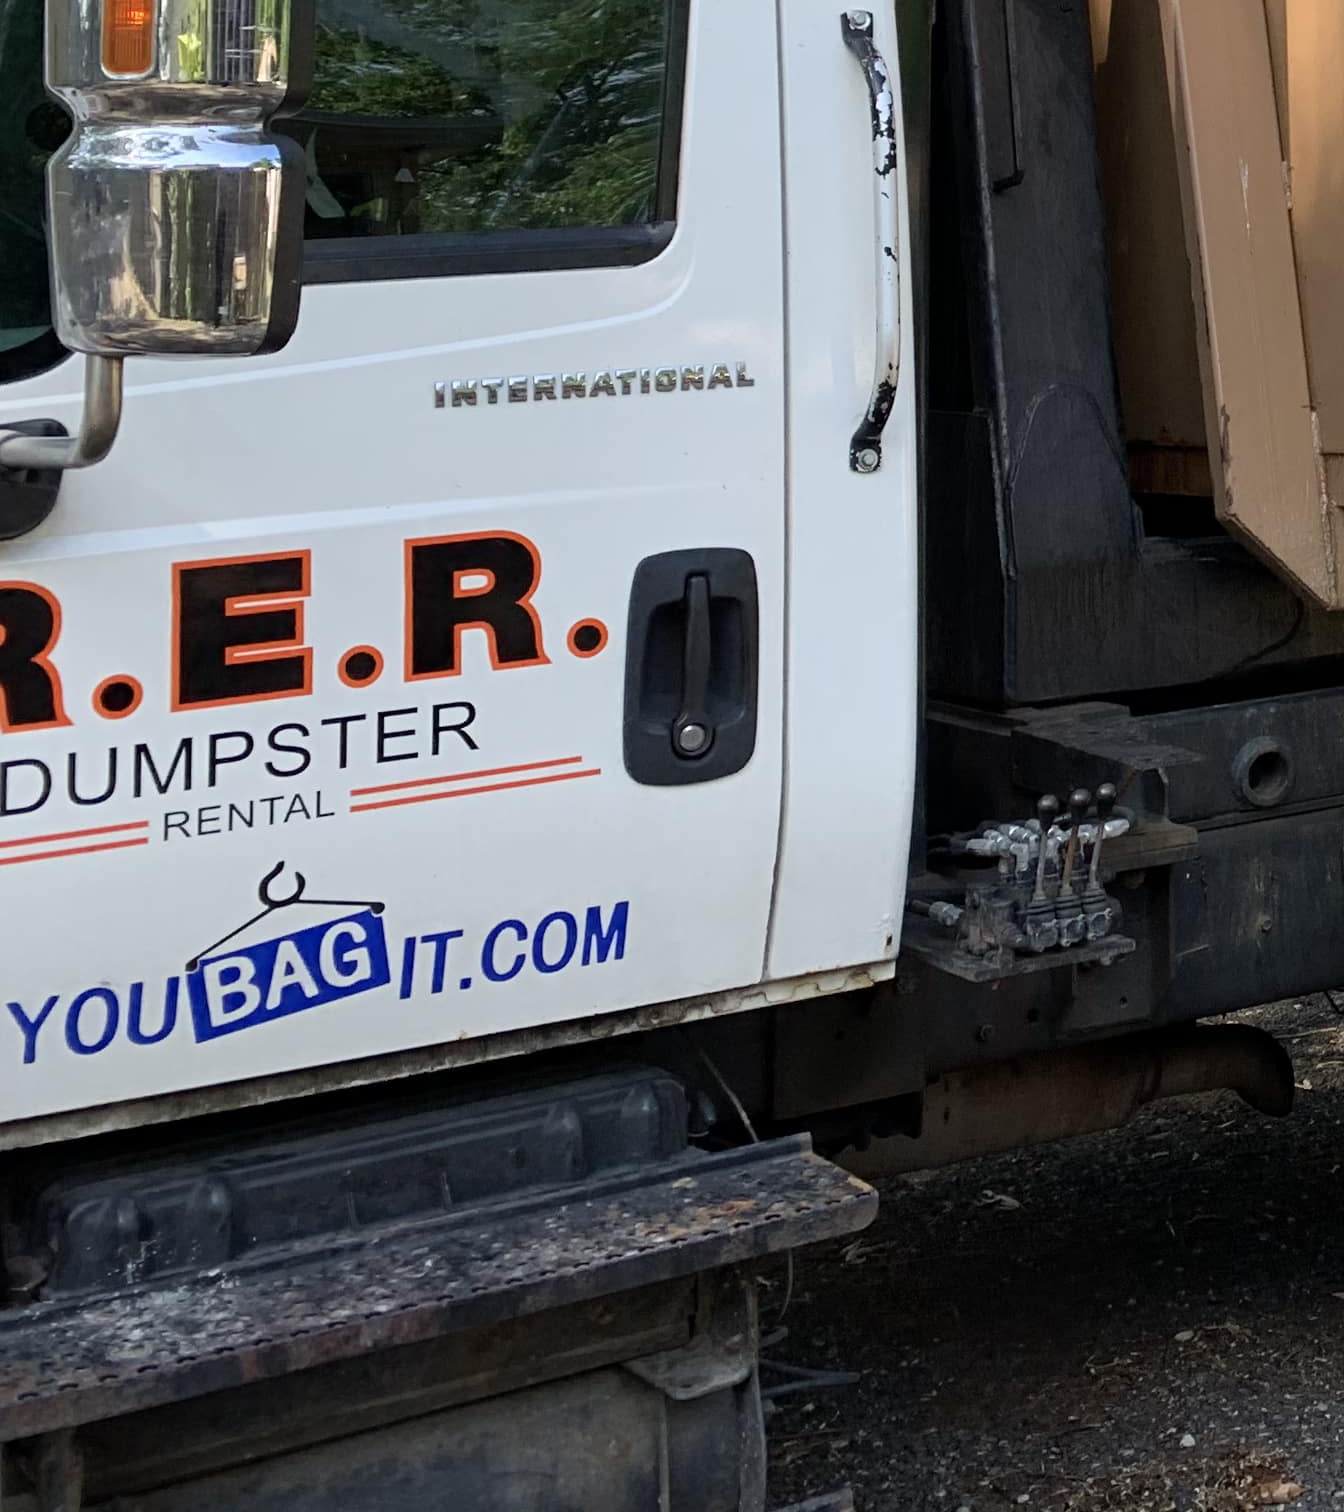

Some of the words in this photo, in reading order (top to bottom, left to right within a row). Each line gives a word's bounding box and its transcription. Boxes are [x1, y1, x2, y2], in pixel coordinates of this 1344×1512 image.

[433, 361, 755, 408] INTERNATIONAL
[0, 529, 608, 735] R.E.R.
[0, 701, 480, 817] DUMPSTER
[162, 790, 336, 842] RENTAL
